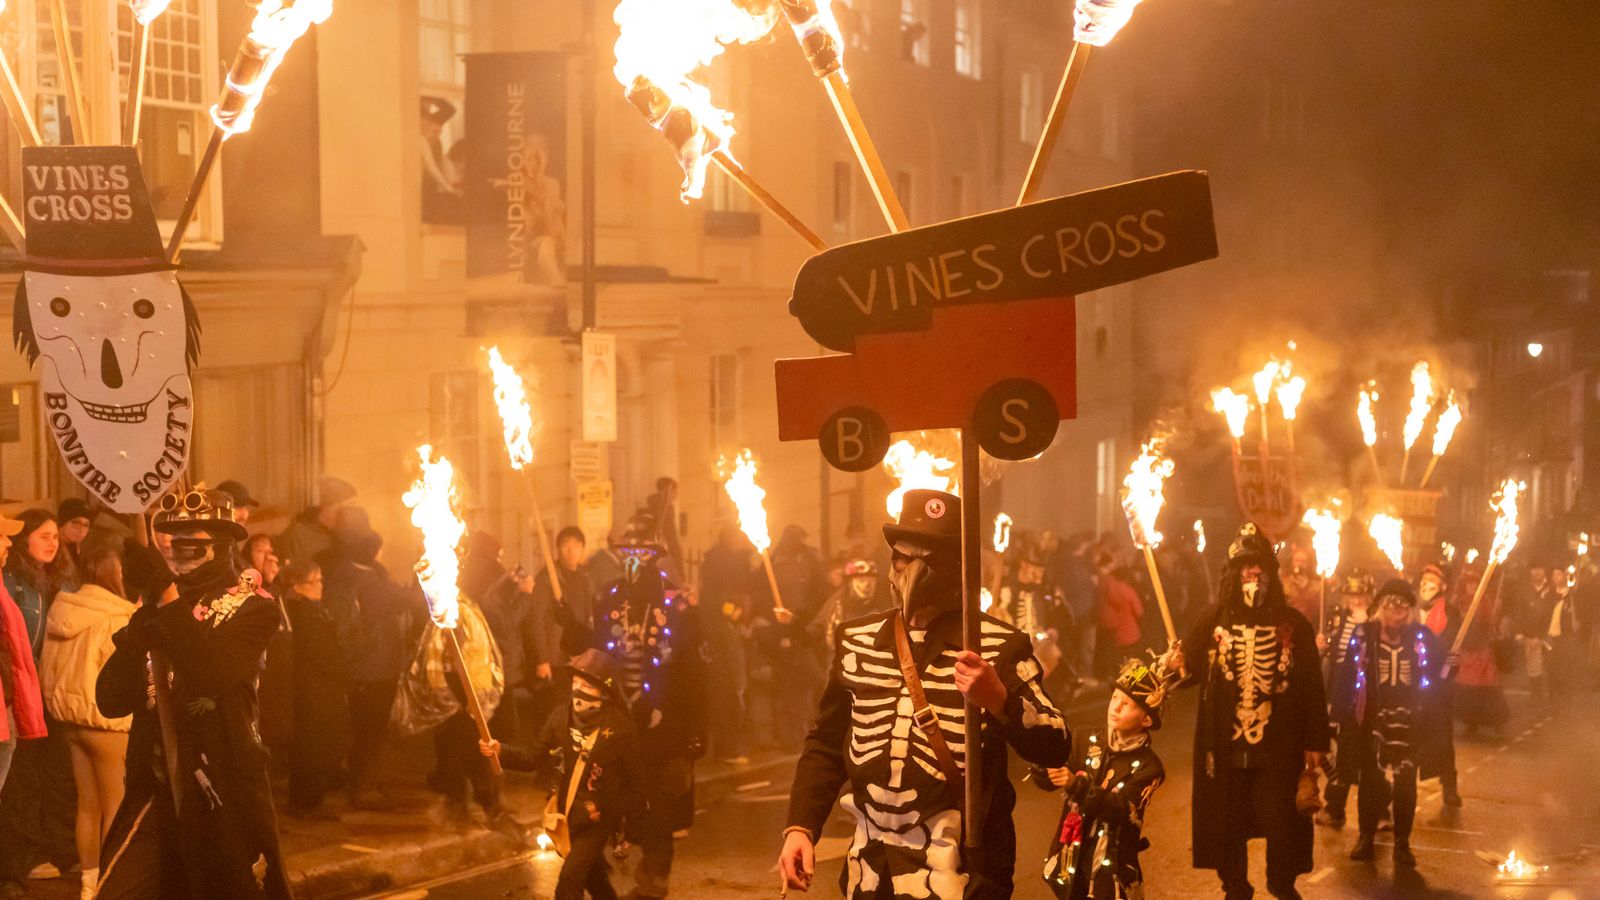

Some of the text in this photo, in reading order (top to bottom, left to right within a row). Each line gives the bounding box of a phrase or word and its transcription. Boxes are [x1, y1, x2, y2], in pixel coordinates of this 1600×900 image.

[27, 165, 129, 192] VINES
[27, 194, 133, 221] CROSS
[839, 209, 1167, 315] VINES CROSS
[46, 388, 189, 504] BONFIRE SOCIETY
[837, 399, 1029, 462] B S
